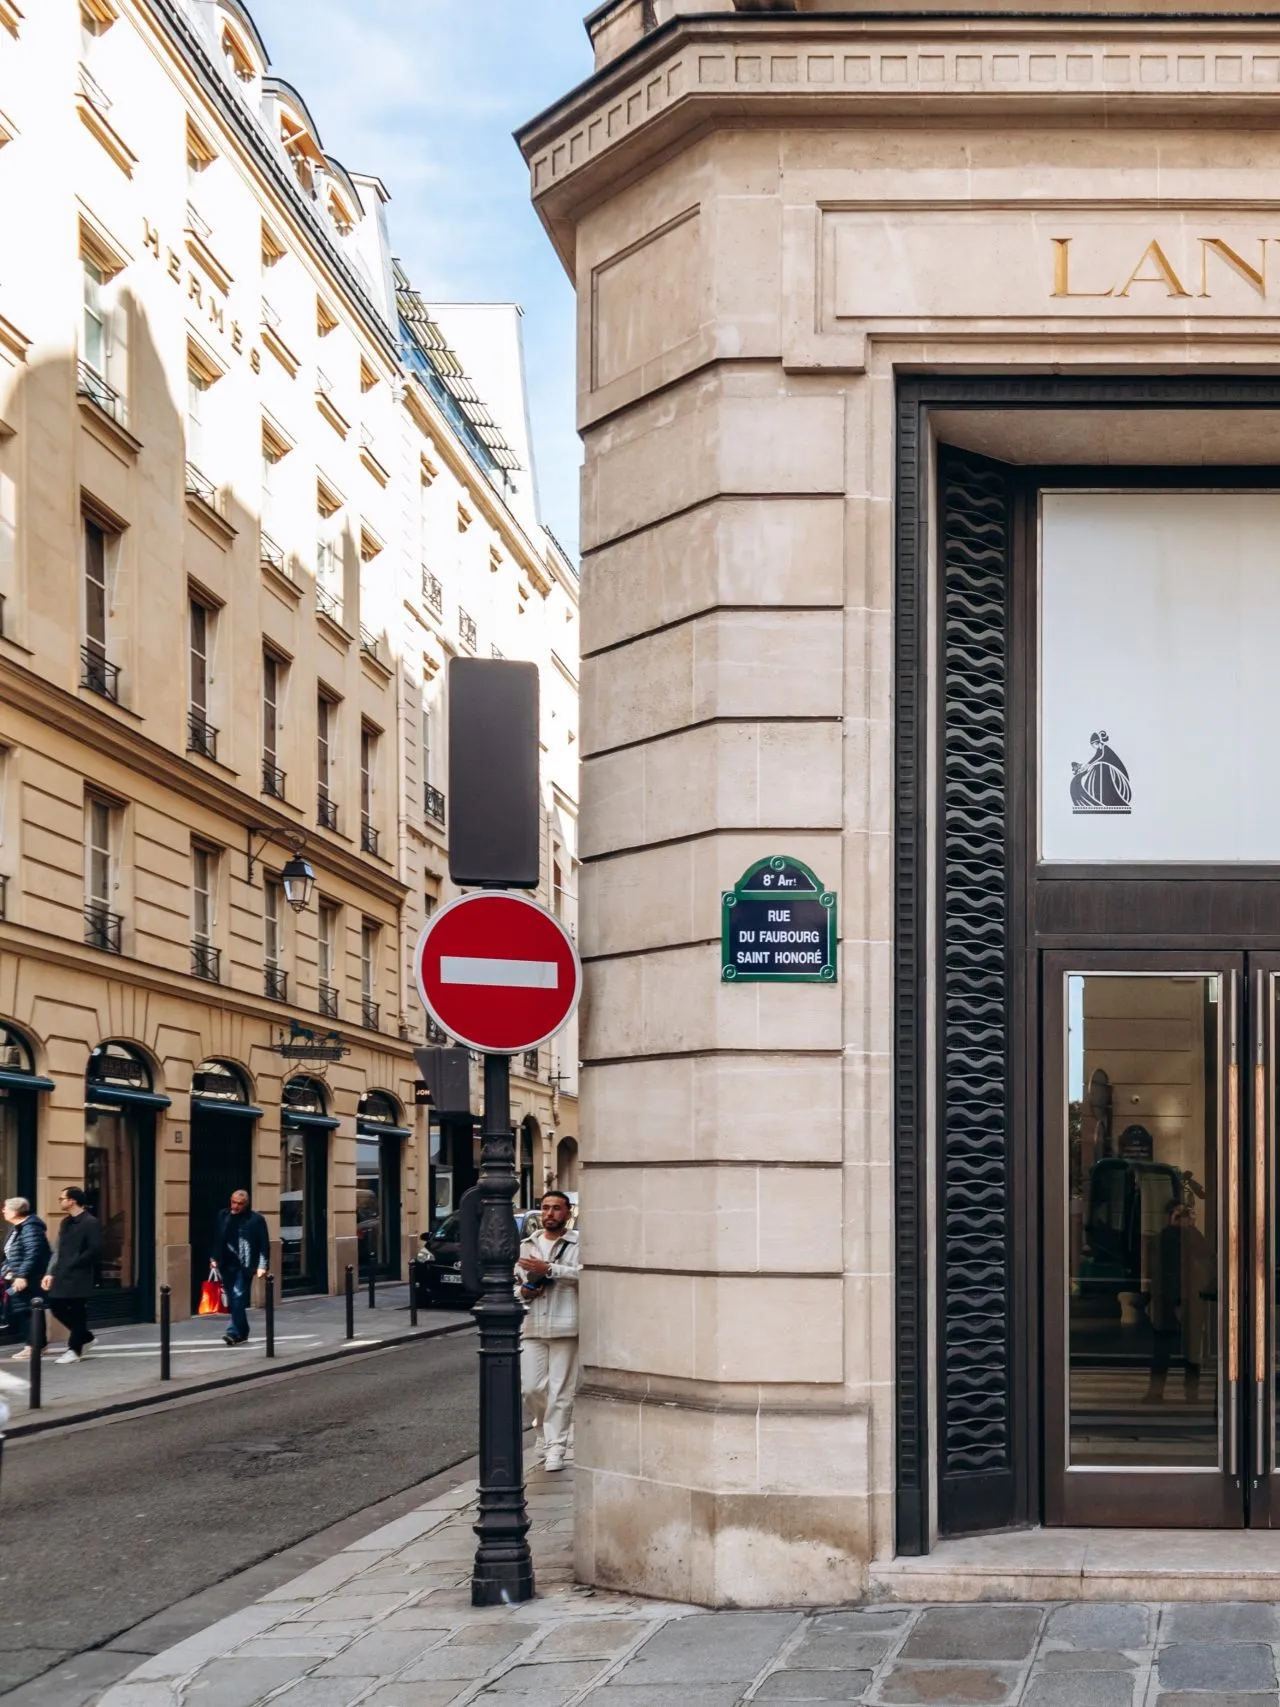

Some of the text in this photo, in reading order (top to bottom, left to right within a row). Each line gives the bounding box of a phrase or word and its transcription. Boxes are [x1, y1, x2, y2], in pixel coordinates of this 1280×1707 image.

[768, 910, 791, 922] RUE
[739, 931, 820, 943] DU FAUBOURG
[737, 949, 822, 964] SAINT HONORÉ
